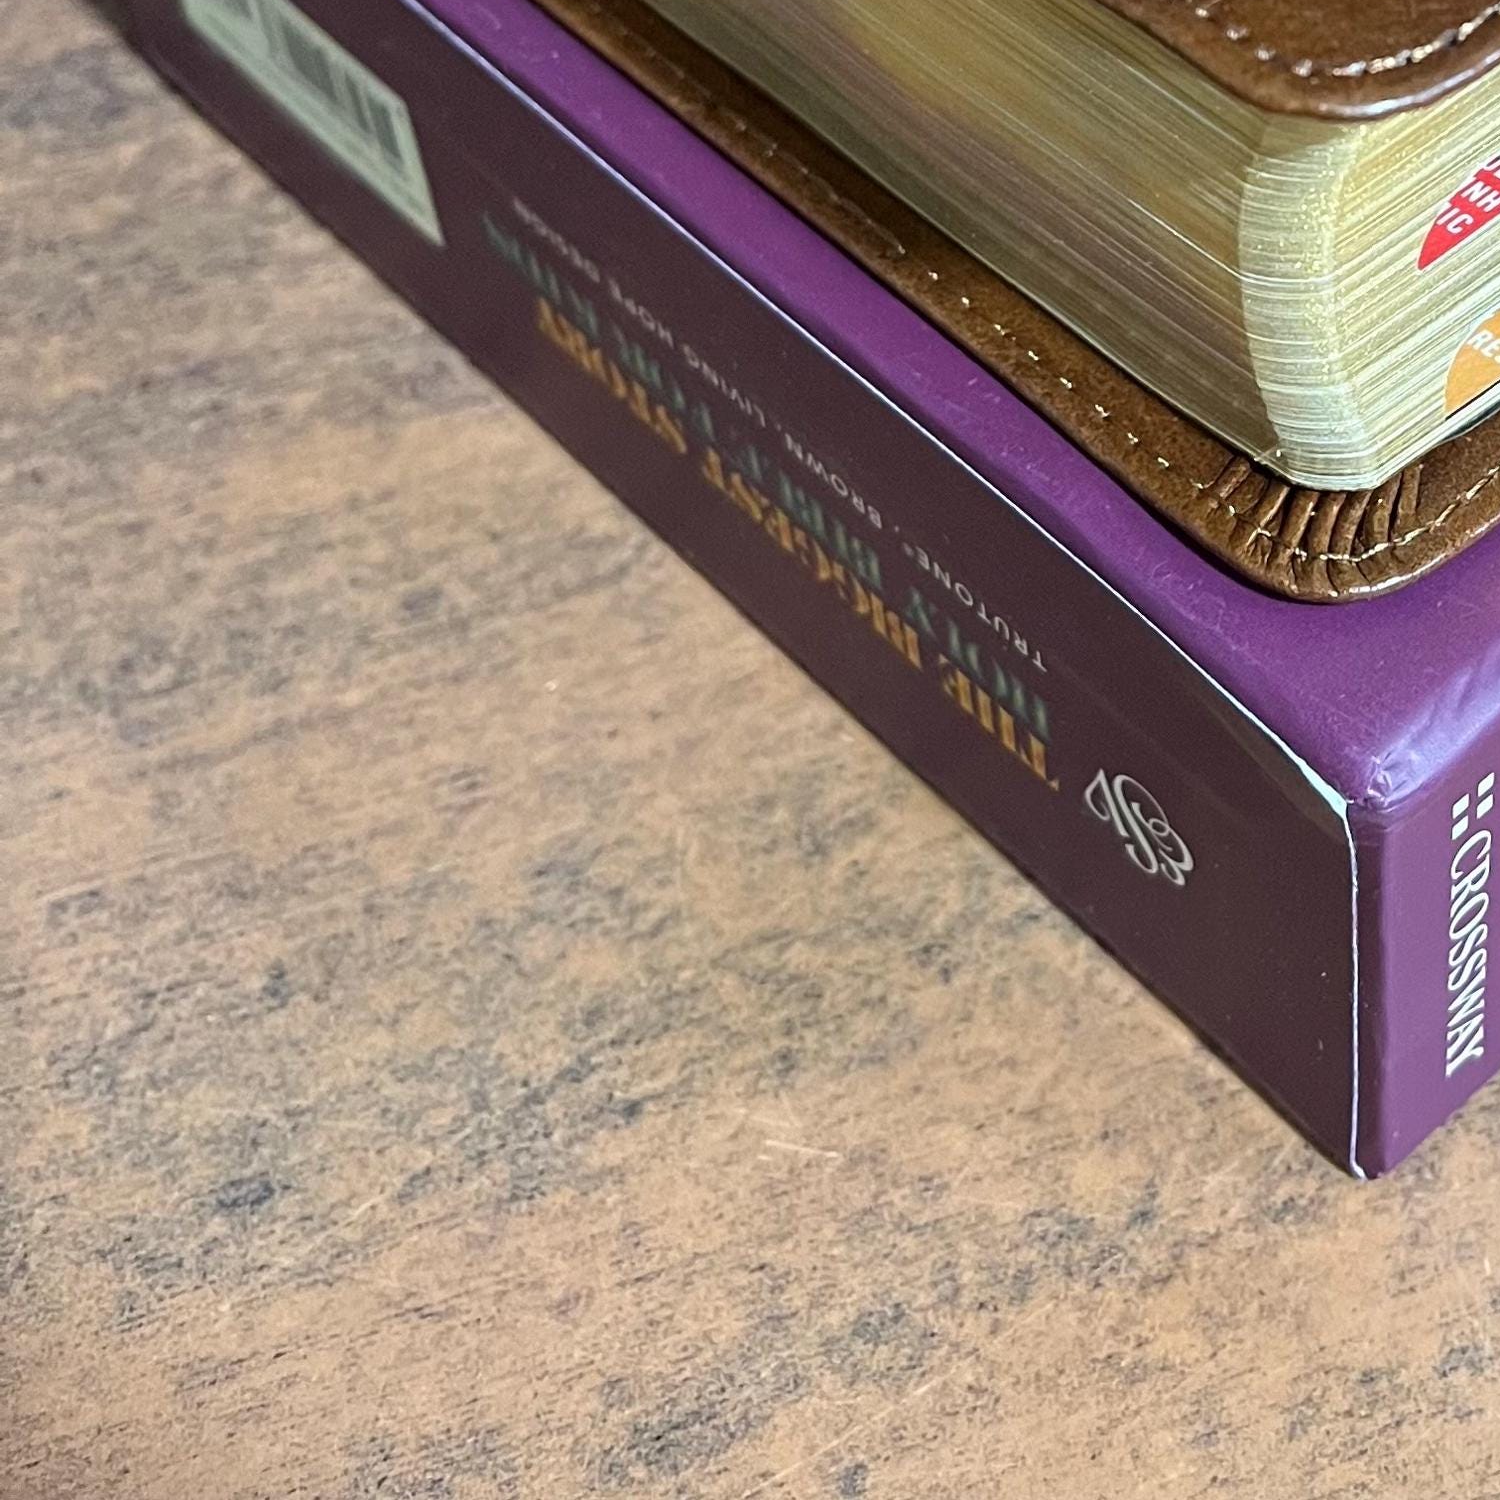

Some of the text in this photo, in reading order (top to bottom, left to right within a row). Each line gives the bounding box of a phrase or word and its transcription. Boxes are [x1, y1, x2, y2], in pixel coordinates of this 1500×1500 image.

[1436, 208, 1474, 235] IC
[682, 343, 766, 428] LIVING
[700, 444, 923, 671] BIGGEST
[904, 584, 1050, 740] HOLY
[938, 652, 1060, 792] THE
[1445, 829, 1493, 1078] CROSSWAY
